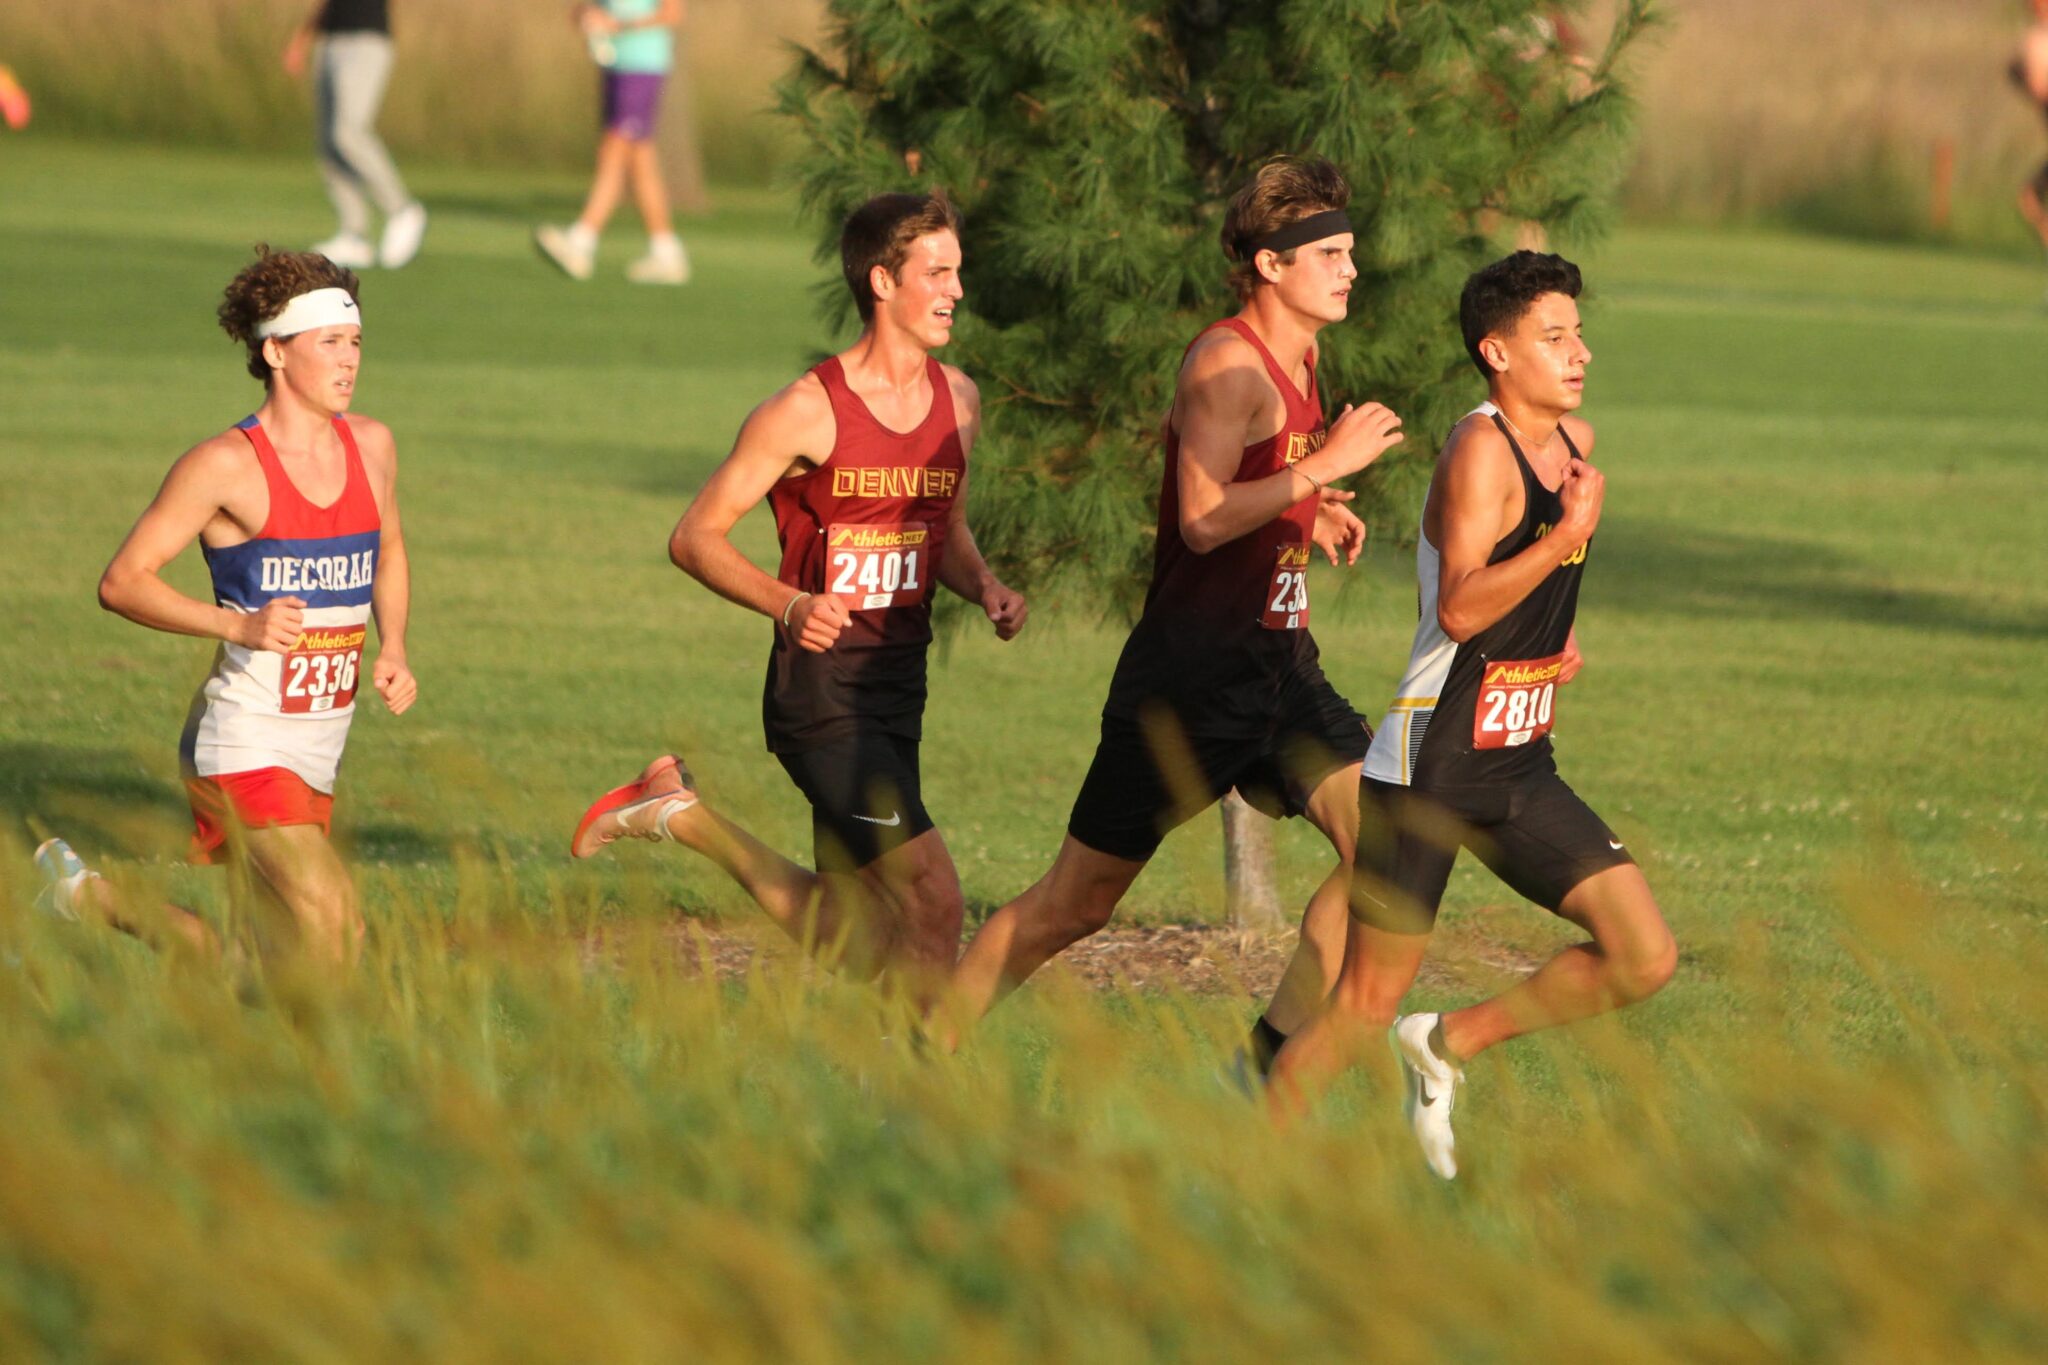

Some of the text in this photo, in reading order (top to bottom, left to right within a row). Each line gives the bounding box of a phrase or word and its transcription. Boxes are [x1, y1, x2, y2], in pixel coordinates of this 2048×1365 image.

[832, 467, 958, 498] DENVER
[261, 550, 373, 591] DECORAH
[832, 551, 918, 594] 2401
[286, 651, 358, 697] 2336
[1481, 683, 1554, 732] 2810
